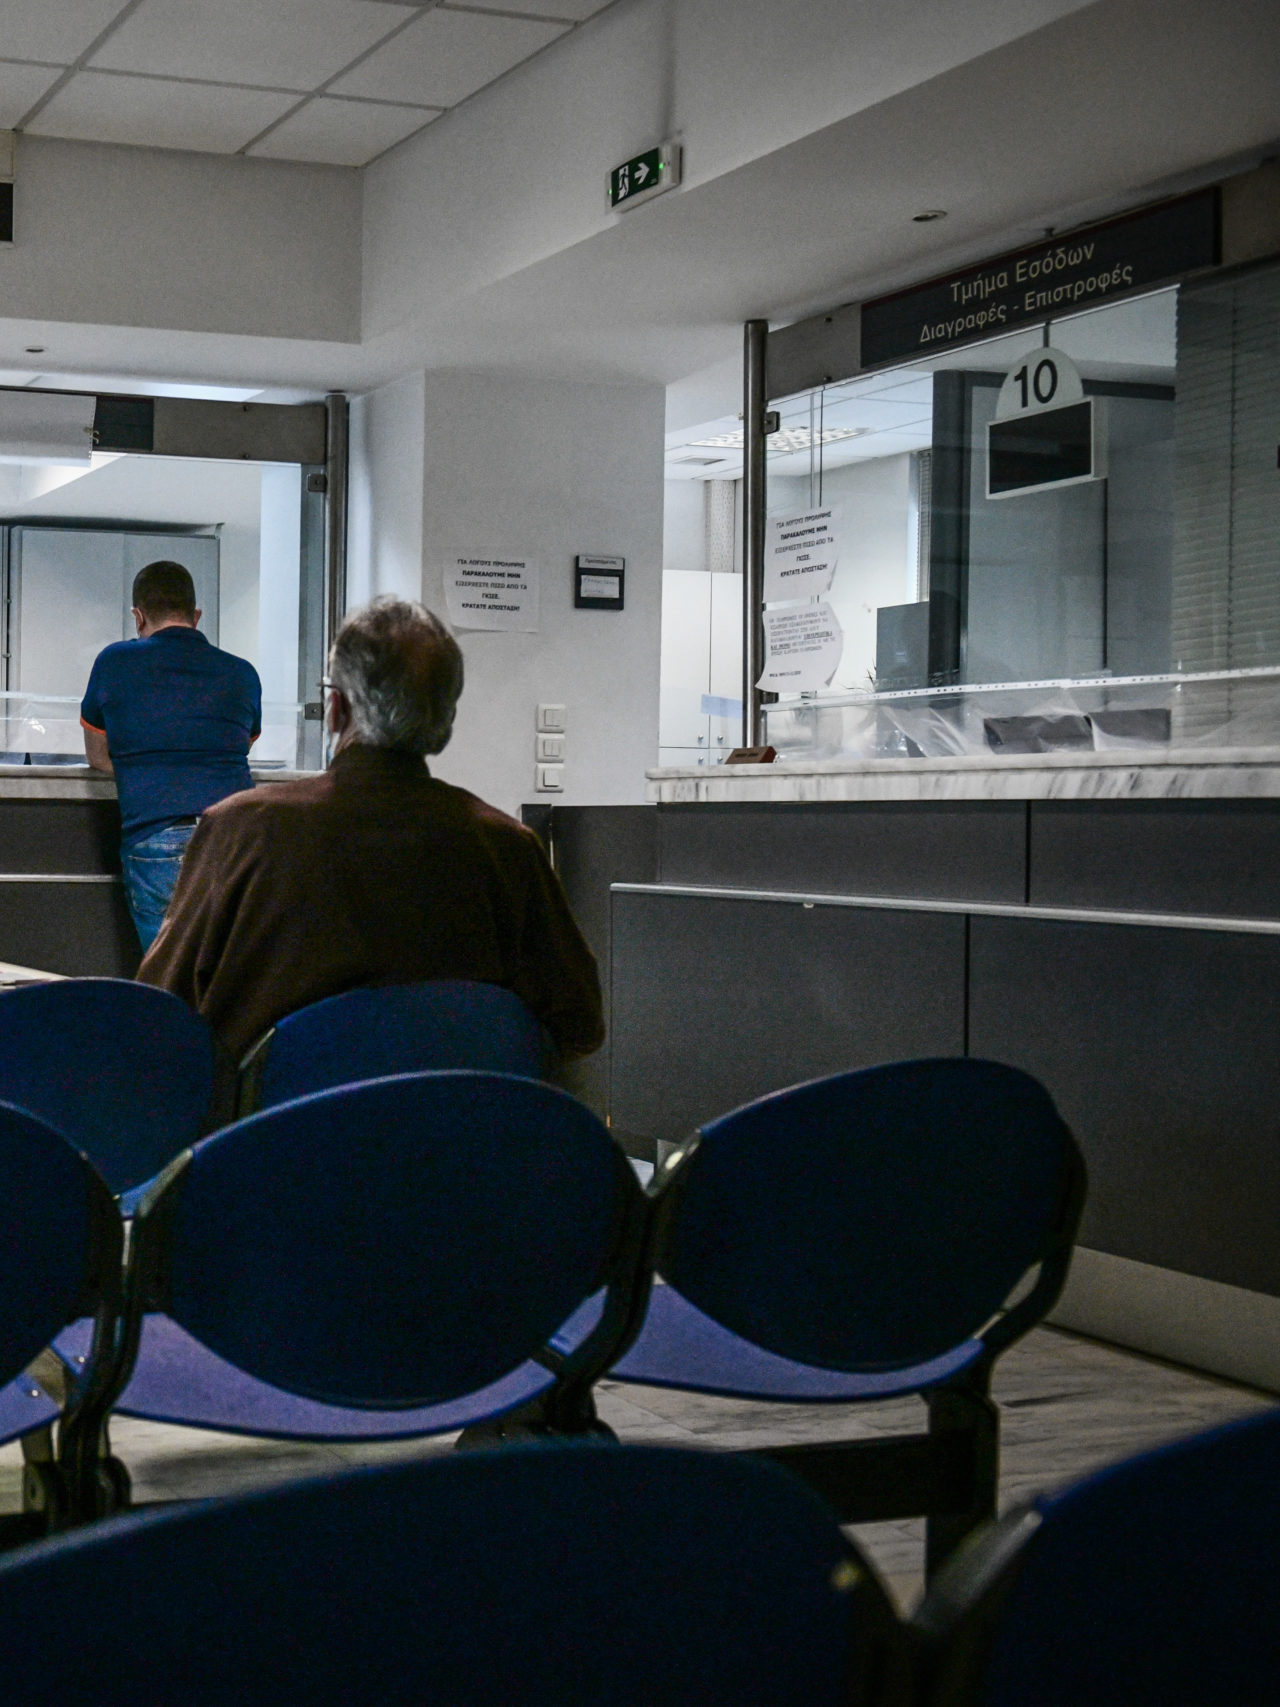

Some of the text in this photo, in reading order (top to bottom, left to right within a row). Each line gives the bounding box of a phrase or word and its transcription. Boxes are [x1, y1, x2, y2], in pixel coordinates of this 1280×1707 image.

[951, 244, 1094, 303] Τμήμα Εσόδων
[920, 303, 1007, 343] Διαγραφές
[1024, 265, 1132, 311] Επιστροφές
[1014, 359, 1058, 408] 10
